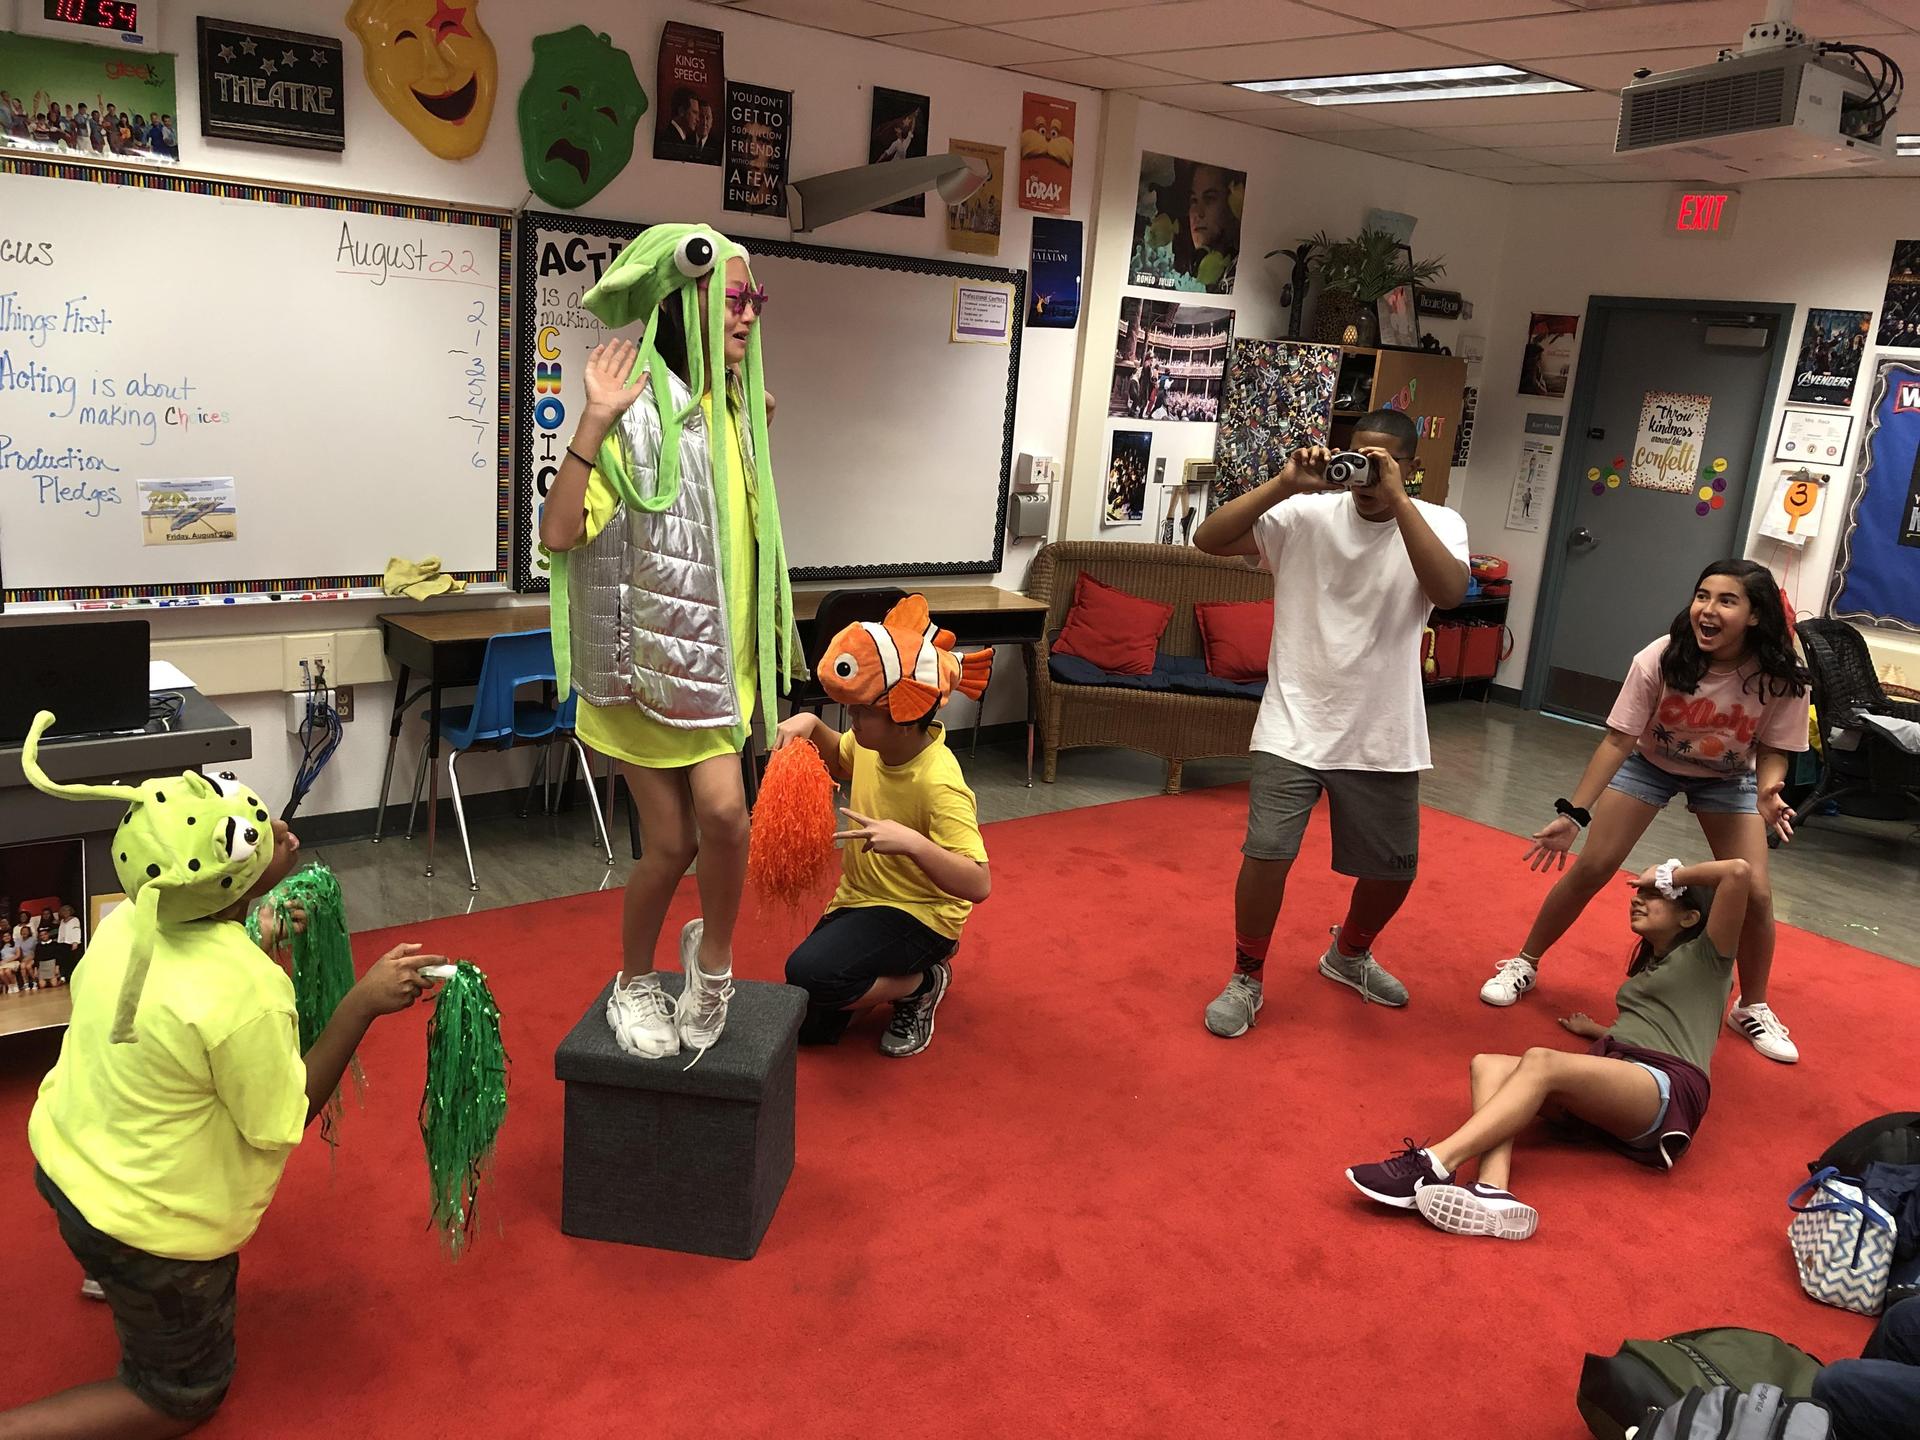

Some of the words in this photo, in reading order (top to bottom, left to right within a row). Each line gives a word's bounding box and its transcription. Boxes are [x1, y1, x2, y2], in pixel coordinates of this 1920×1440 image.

[675, 54, 705, 70] KING'S
[674, 67, 708, 83] SPEECH
[214, 71, 336, 116] THEATRE
[732, 91, 752, 103] YOU
[754, 95, 783, 109] DON'T
[731, 106, 759, 123] GET
[764, 111, 783, 127] TO
[731, 125, 747, 135] 500
[731, 140, 781, 159] FRIENDS
[730, 168, 742, 184] A
[747, 171, 779, 189] FEW
[729, 188, 778, 206] ENEMIES
[1025, 179, 1063, 201] LORAX
[1677, 194, 1728, 231] EXIT
[336, 221, 428, 286] August
[428, 250, 480, 276] 22
[63, 295, 112, 334] First
[467, 301, 488, 326] 2
[0, 350, 76, 418] Acting
[92, 370, 115, 397] is
[126, 373, 196, 400] about
[468, 397, 486, 415] 4
[1656, 405, 1695, 422] Throw
[79, 403, 157, 446] making
[1648, 415, 1695, 437] kindness
[1458, 420, 1475, 467] LOOSE
[472, 451, 487, 468] 6
[1634, 442, 1695, 481] Confetti
[32, 474, 122, 517] Pledges
[1790, 483, 1808, 507] 3
[1485, 1213, 1497, 1236] NIKE
